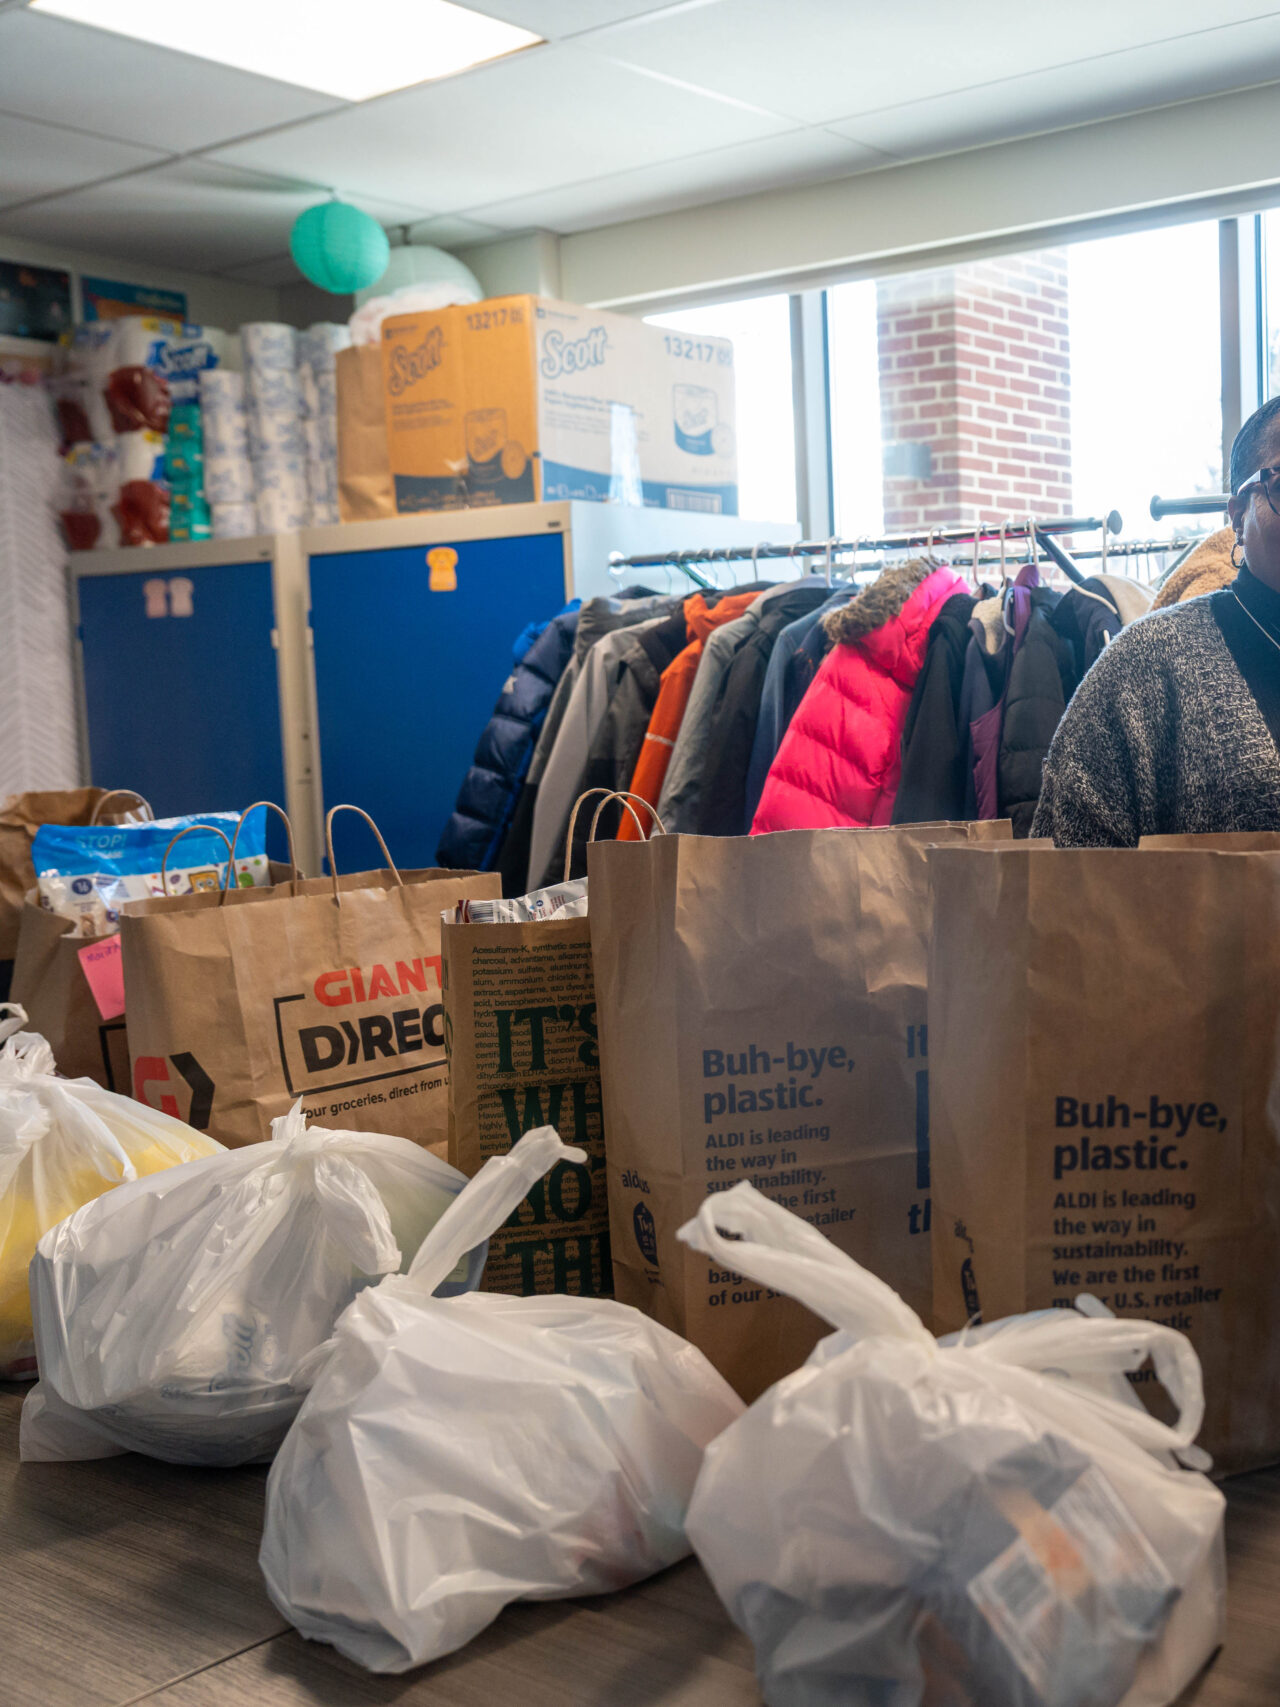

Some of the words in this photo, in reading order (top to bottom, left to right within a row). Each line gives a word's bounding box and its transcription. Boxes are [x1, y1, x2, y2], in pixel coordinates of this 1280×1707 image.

[541, 326, 608, 379] Scott
[664, 336, 714, 363] 13217
[314, 955, 442, 1008] GIANT
[472, 966, 513, 977] potassium
[517, 964, 546, 975] sulfate,
[473, 977, 495, 987] alum,
[499, 975, 544, 985] ammonium
[473, 988, 503, 997] extract,
[474, 999, 493, 1008] acid,
[702, 1041, 856, 1079] Buh-bye,
[330, 1093, 387, 1117] groceries,
[389, 1083, 419, 1101] direct
[420, 1078, 442, 1094] from
[704, 1077, 824, 1124] plastic.
[1055, 1095, 1228, 1138] Buh-bye,
[705, 1131, 745, 1149] ALDI
[750, 1129, 764, 1146] is
[768, 1123, 831, 1144] leading
[706, 1154, 736, 1172] the
[741, 1152, 777, 1171] way
[781, 1149, 797, 1165] in
[1053, 1135, 1189, 1181] plastic.
[706, 1167, 827, 1194] susinability.
[803, 1187, 837, 1205] first
[1053, 1192, 1097, 1210] ALDI
[1102, 1190, 1118, 1208] is
[1121, 1188, 1197, 1211] leading
[491, 1229, 545, 1241] opylparaben,
[1054, 1217, 1087, 1236] the
[1091, 1219, 1132, 1239] way
[1137, 1214, 1156, 1233] in
[1052, 1238, 1189, 1261] sustainability.
[708, 1269, 748, 1285] bag
[1052, 1269, 1081, 1287] We
[1085, 1269, 1119, 1285] are
[1123, 1264, 1156, 1283] the
[1161, 1263, 1200, 1282] first
[708, 1290, 726, 1306] of
[731, 1288, 762, 1305] our
[1114, 1291, 1150, 1309] U.S.
[1154, 1286, 1223, 1308] retailer
